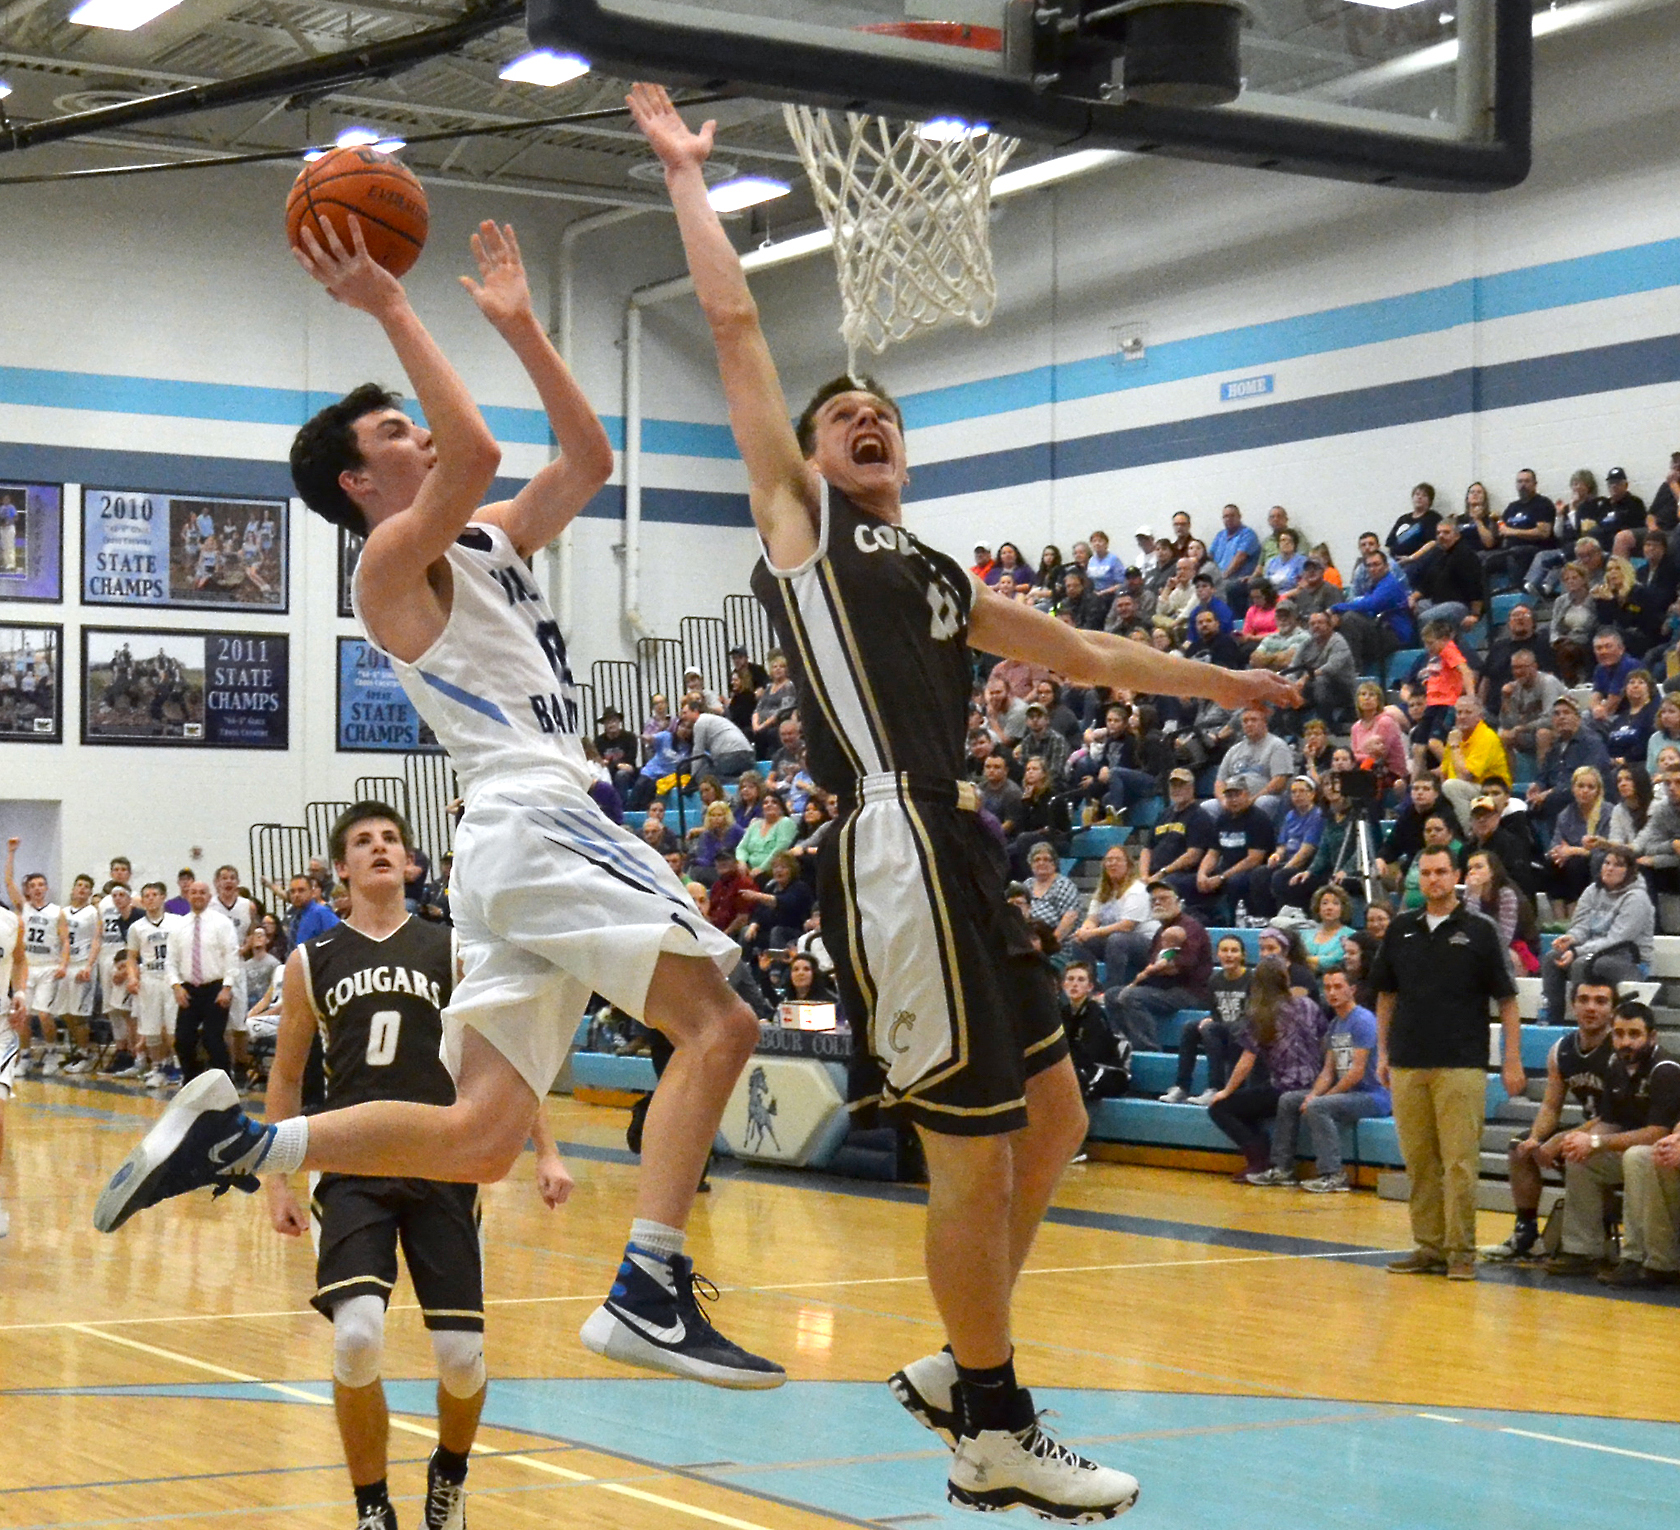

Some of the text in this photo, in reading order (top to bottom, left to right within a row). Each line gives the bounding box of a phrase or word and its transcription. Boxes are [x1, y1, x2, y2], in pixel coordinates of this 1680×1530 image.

[1228, 379, 1266, 398] HOME
[100, 495, 153, 521] 2010
[97, 552, 157, 573] STATE
[89, 576, 163, 598] CHAMPS
[218, 638, 268, 662] 2011
[355, 645, 390, 669] 201
[214, 667, 272, 687] STATE
[208, 691, 279, 711] CHAMPS
[351, 702, 408, 722] STATE
[344, 723, 414, 743] CHAMPS
[28, 927, 45, 943] 32
[325, 966, 440, 1016] COUGARS
[365, 1011, 401, 1066] 0
